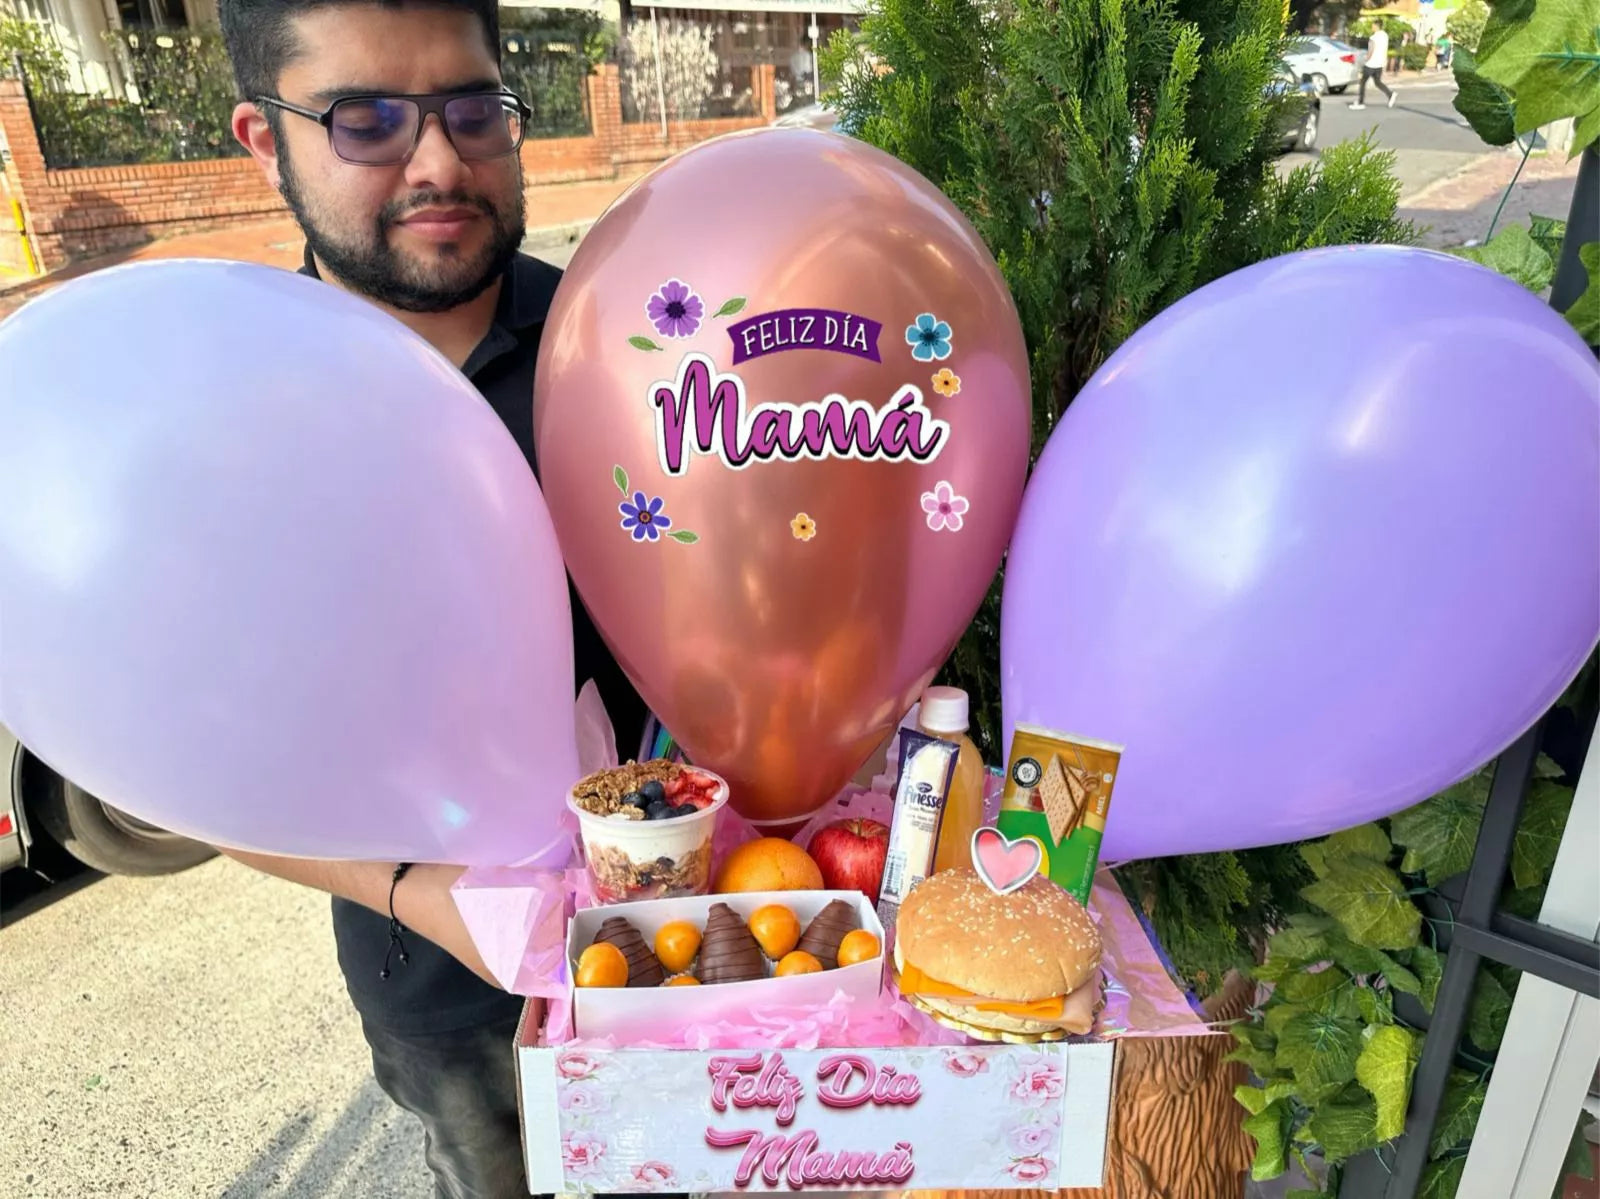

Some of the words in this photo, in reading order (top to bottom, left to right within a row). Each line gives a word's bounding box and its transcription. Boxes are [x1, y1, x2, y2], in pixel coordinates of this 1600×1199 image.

[740, 316, 816, 356] FELIZ
[823, 315, 870, 352] DÍA
[652, 357, 945, 474] Mamá
[1095, 795, 1107, 815] MIEL
[707, 1052, 804, 1126] Feliz
[704, 1126, 915, 1190] Mamá
